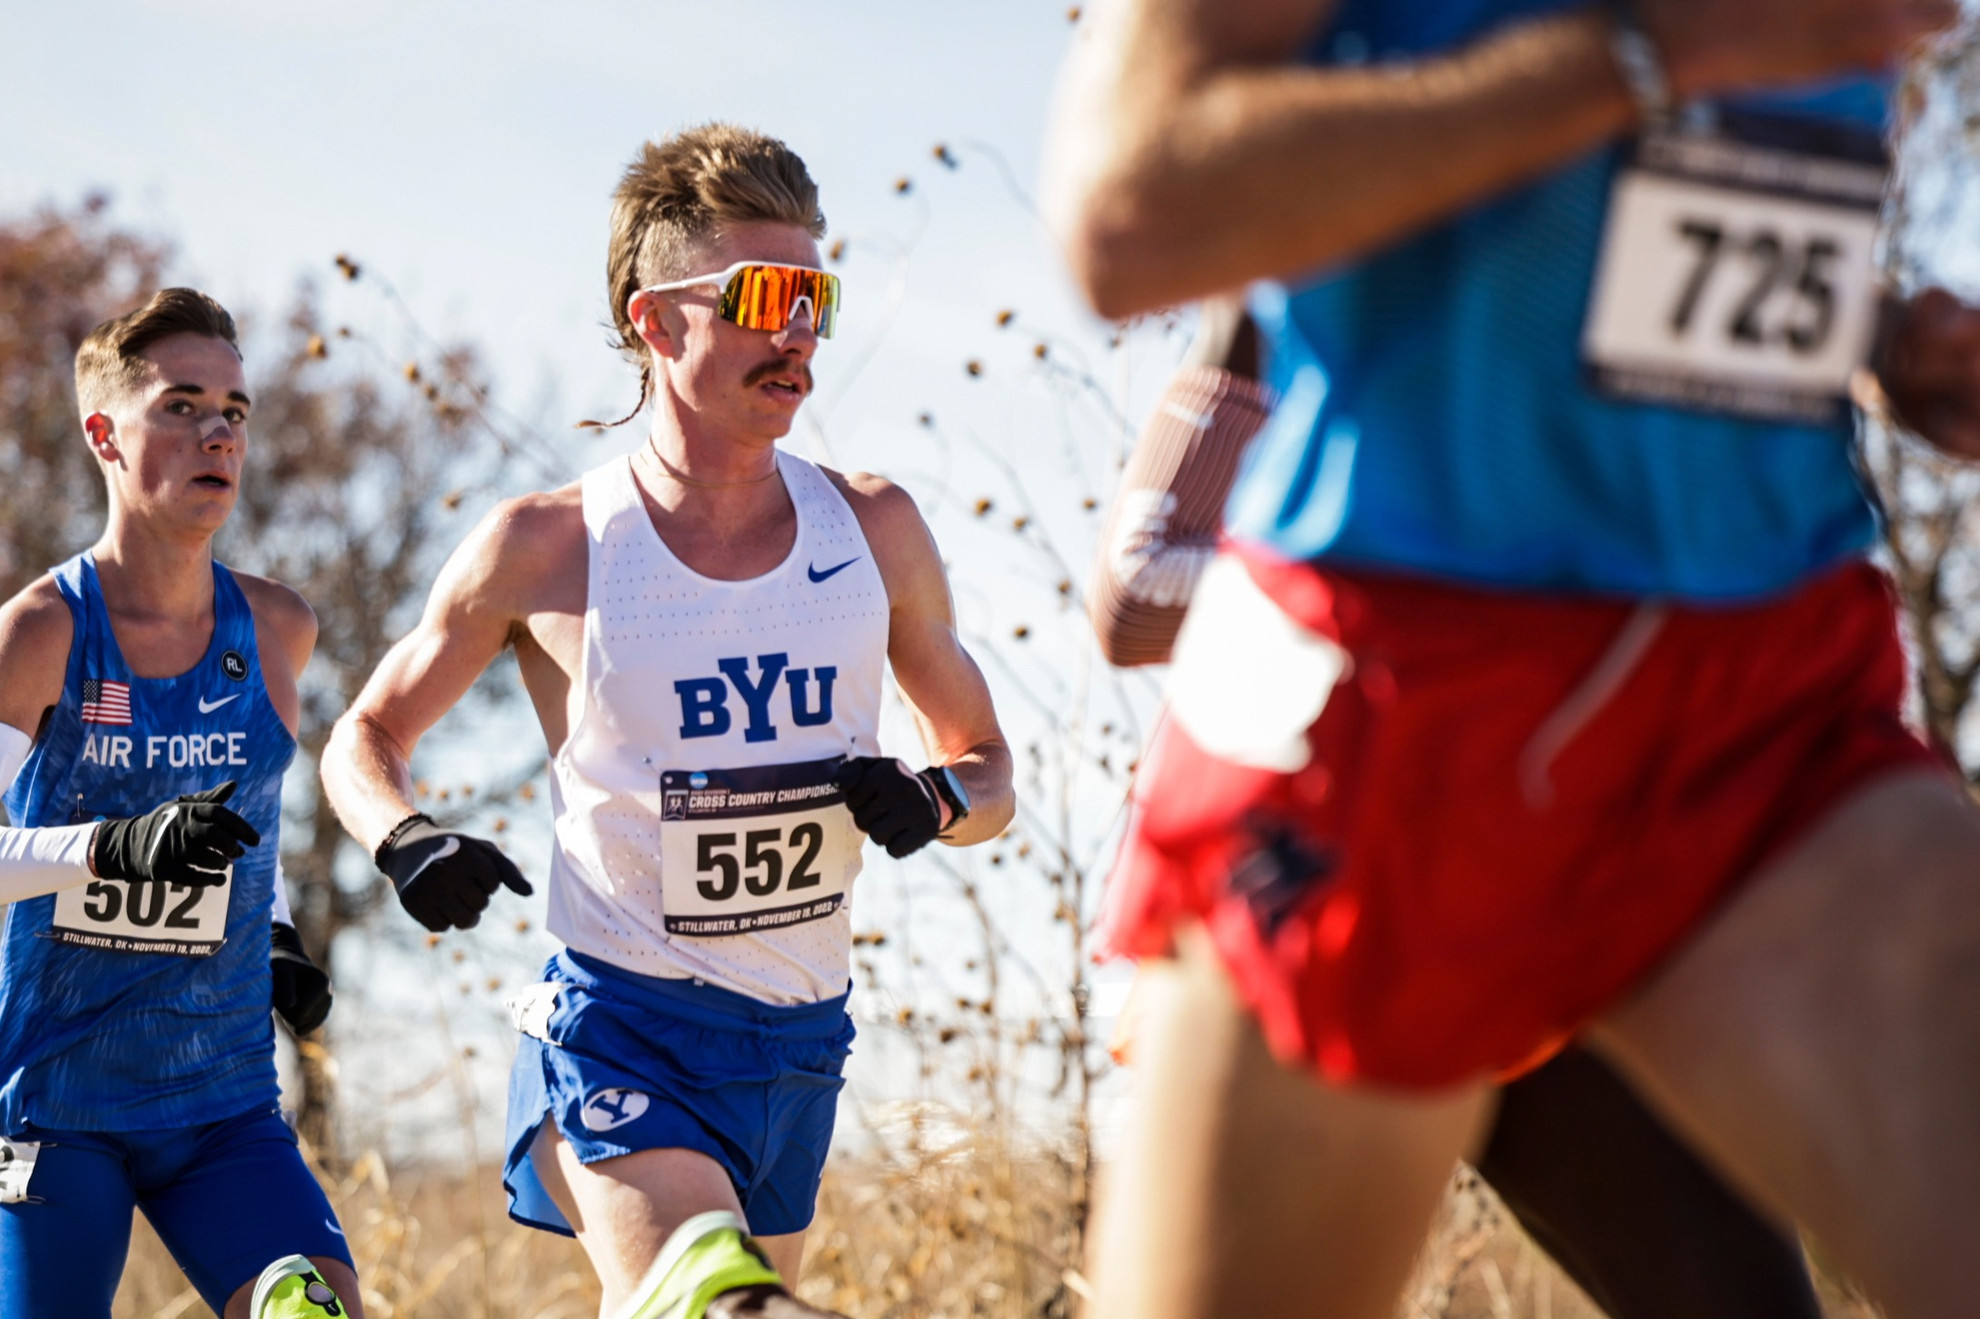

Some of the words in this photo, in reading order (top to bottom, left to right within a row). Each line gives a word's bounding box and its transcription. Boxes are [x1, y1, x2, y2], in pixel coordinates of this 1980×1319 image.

[1667, 217, 1838, 356] 725
[226, 657, 243, 673] RL
[674, 652, 837, 743] BYU
[82, 732, 133, 769] AIR
[146, 732, 247, 769] FORCE
[688, 794, 727, 809] CROSS
[728, 791, 776, 808] COUNTRY
[696, 821, 823, 901] 552
[83, 881, 205, 929] 502
[678, 920, 738, 933] STILLWATER,
[757, 909, 802, 926] NOVEMBER
[63, 932, 113, 949] STILLWATER,
[133, 942, 176, 953] NOVEMBER
[590, 1089, 634, 1124] Y
